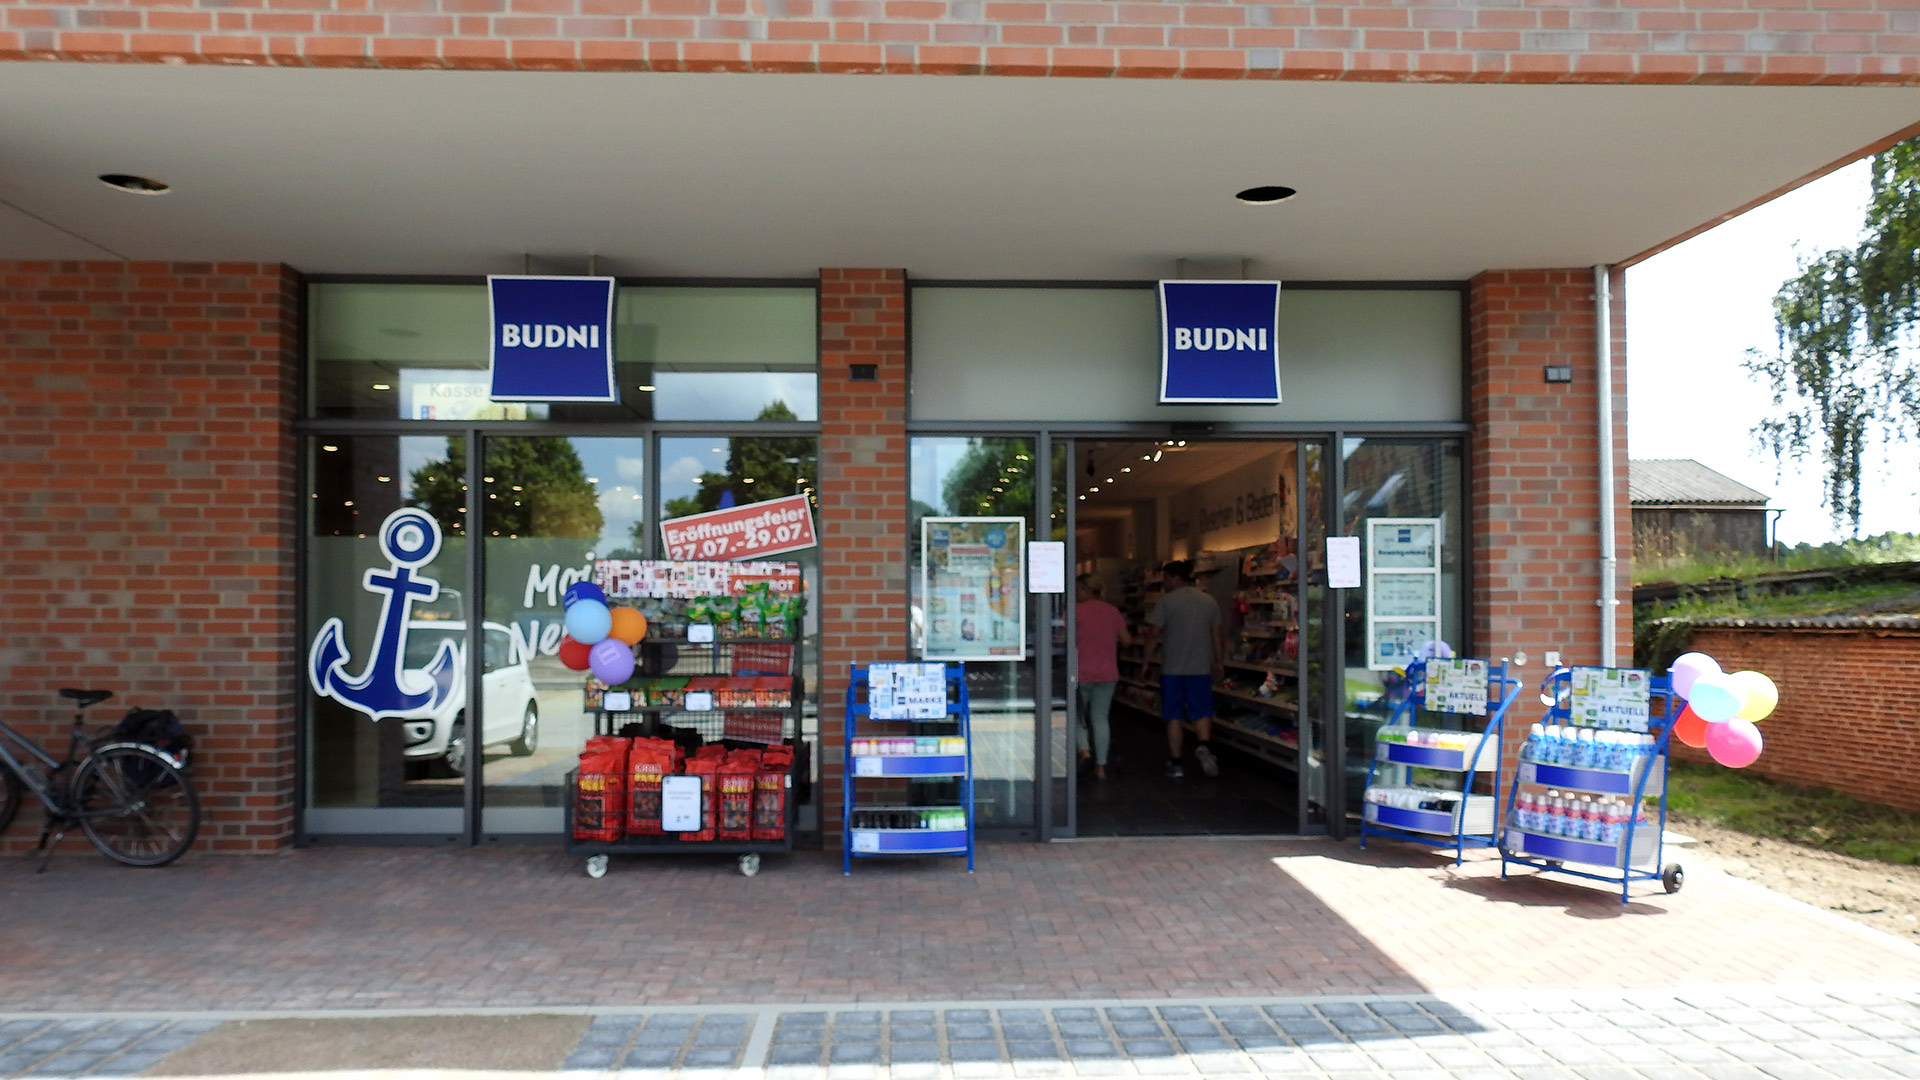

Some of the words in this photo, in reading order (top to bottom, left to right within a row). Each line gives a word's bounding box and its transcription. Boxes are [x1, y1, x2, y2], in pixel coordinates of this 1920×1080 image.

[502, 323, 599, 349] BUDNI
[1175, 327, 1267, 351] BUDNI
[430, 383, 483, 398] Kasse
[667, 507, 806, 545] Eröffnungsfeier
[671, 522, 811, 561] 27.07.-29.07.
[733, 578, 796, 592] ABOT
[1601, 704, 1645, 716] AKTUELL
